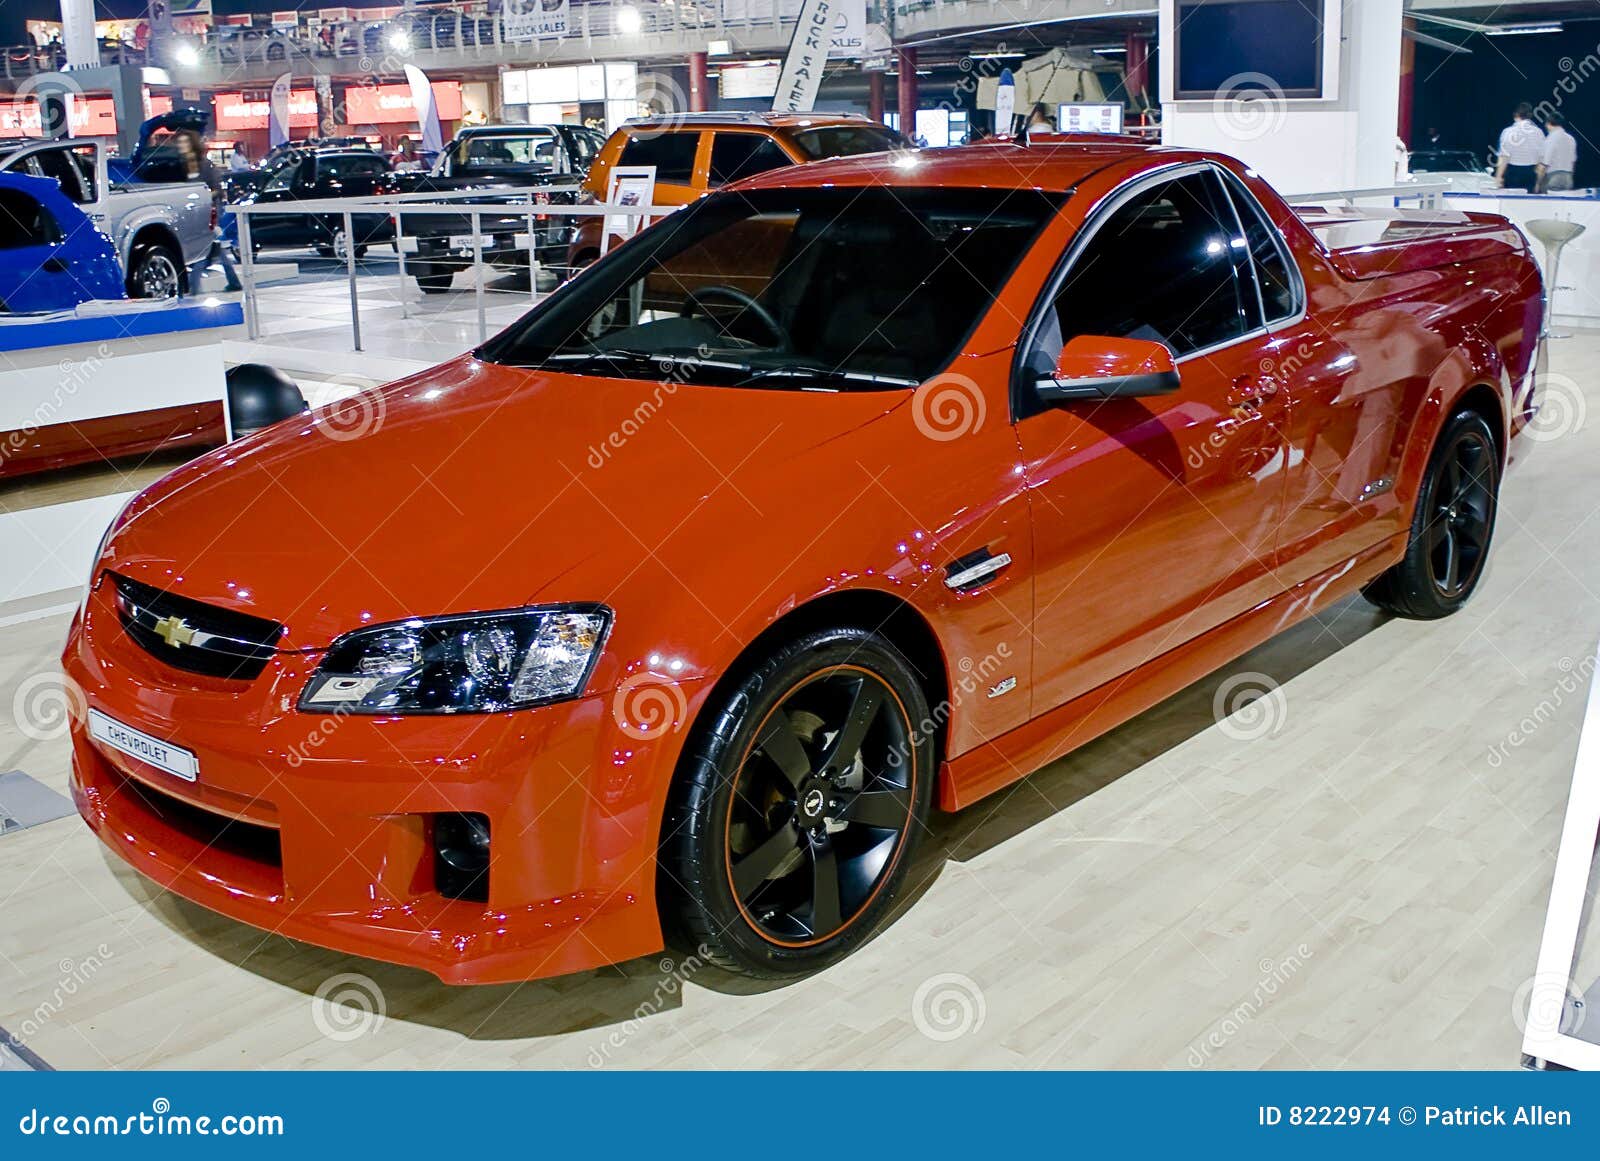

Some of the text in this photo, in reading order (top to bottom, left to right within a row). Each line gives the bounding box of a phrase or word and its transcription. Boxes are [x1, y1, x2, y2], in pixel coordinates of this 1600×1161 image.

[539, 22, 566, 34] SALES
[787, 0, 829, 112] RUCK SALES
[107, 725, 168, 762] CHEVROLET
